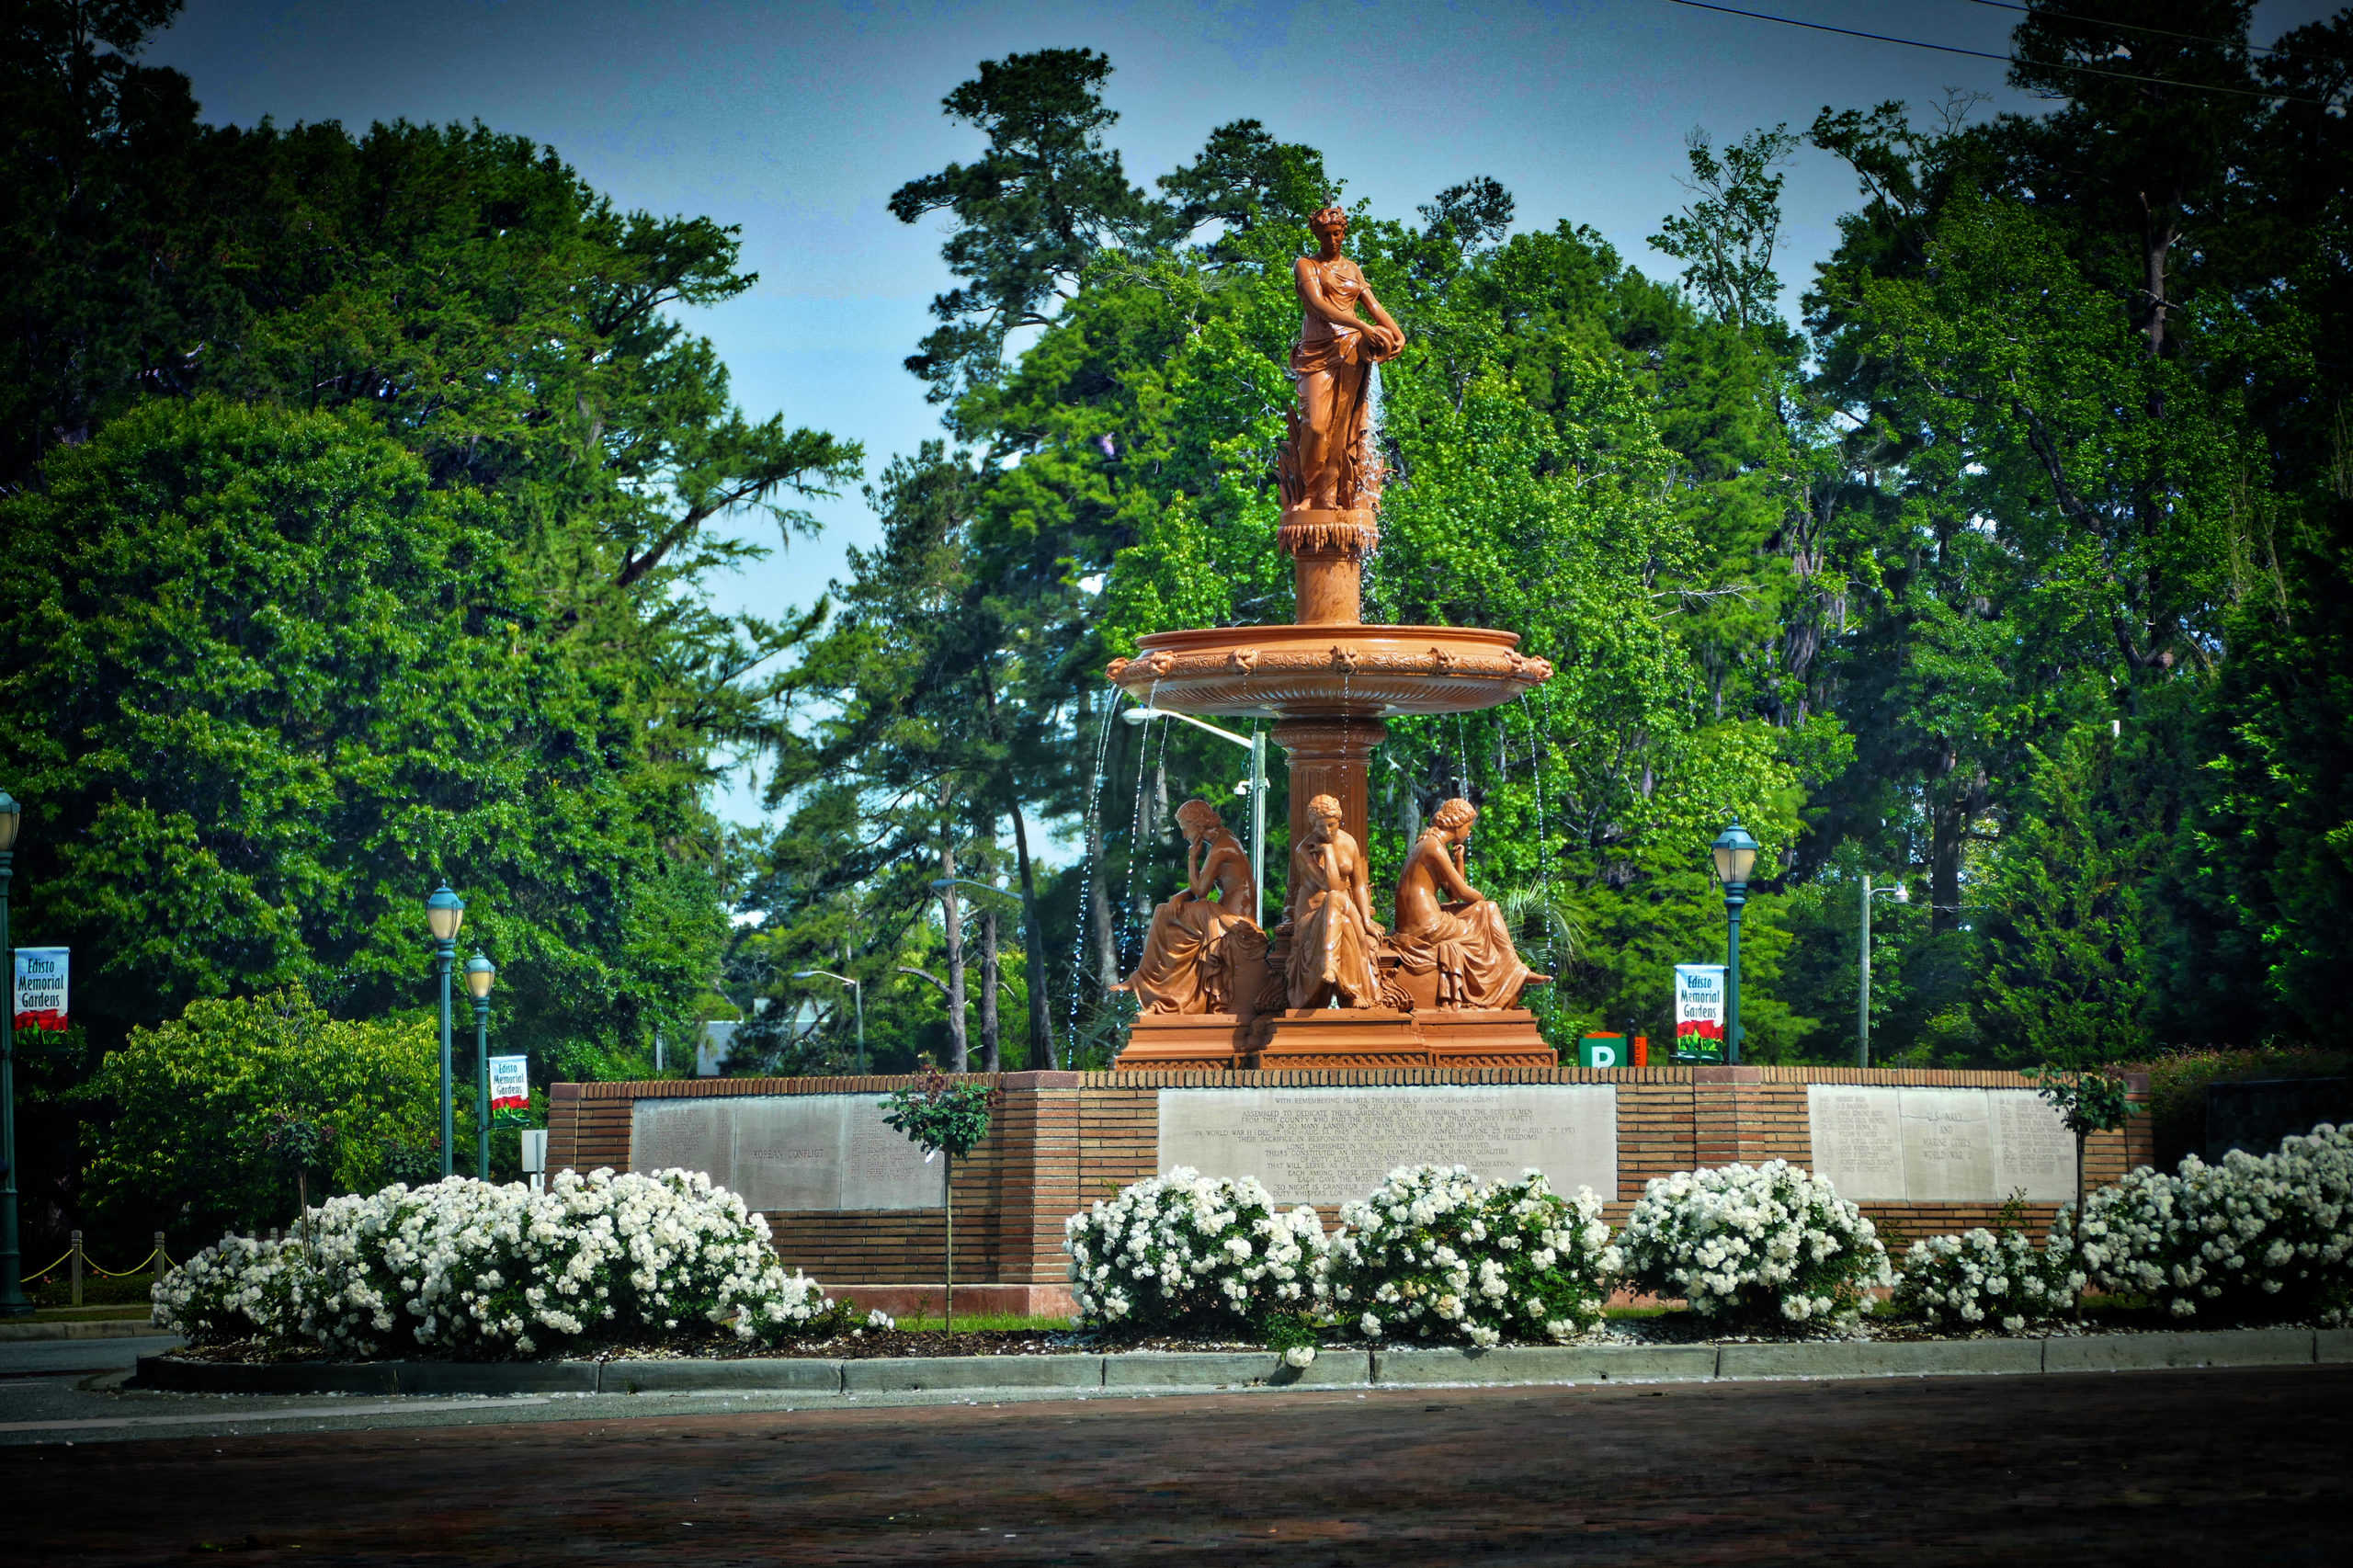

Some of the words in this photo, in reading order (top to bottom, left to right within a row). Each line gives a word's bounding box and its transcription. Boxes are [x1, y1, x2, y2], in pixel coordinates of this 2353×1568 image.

[28, 958, 54, 973] Edisto
[18, 974, 63, 991] Memorial
[1688, 975, 1711, 989] Edisto
[22, 993, 60, 1007] Gardens
[1681, 990, 1720, 1004] Memorial
[1684, 1005, 1716, 1018] Gardens
[1592, 1046, 1616, 1067] P
[499, 1063, 517, 1074] Edisto
[494, 1074, 524, 1085] Memorial
[496, 1085, 522, 1095] Gardens
[1939, 1124, 1953, 1134] AND
[1922, 1138, 1947, 1147] MARINE
[1951, 1138, 1972, 1147] CORPS
[753, 1150, 781, 1159] KOREAN
[788, 1149, 824, 1158] CONFLICT
[1923, 1151, 1946, 1160] WORLD
[1949, 1151, 1963, 1160] WAR
